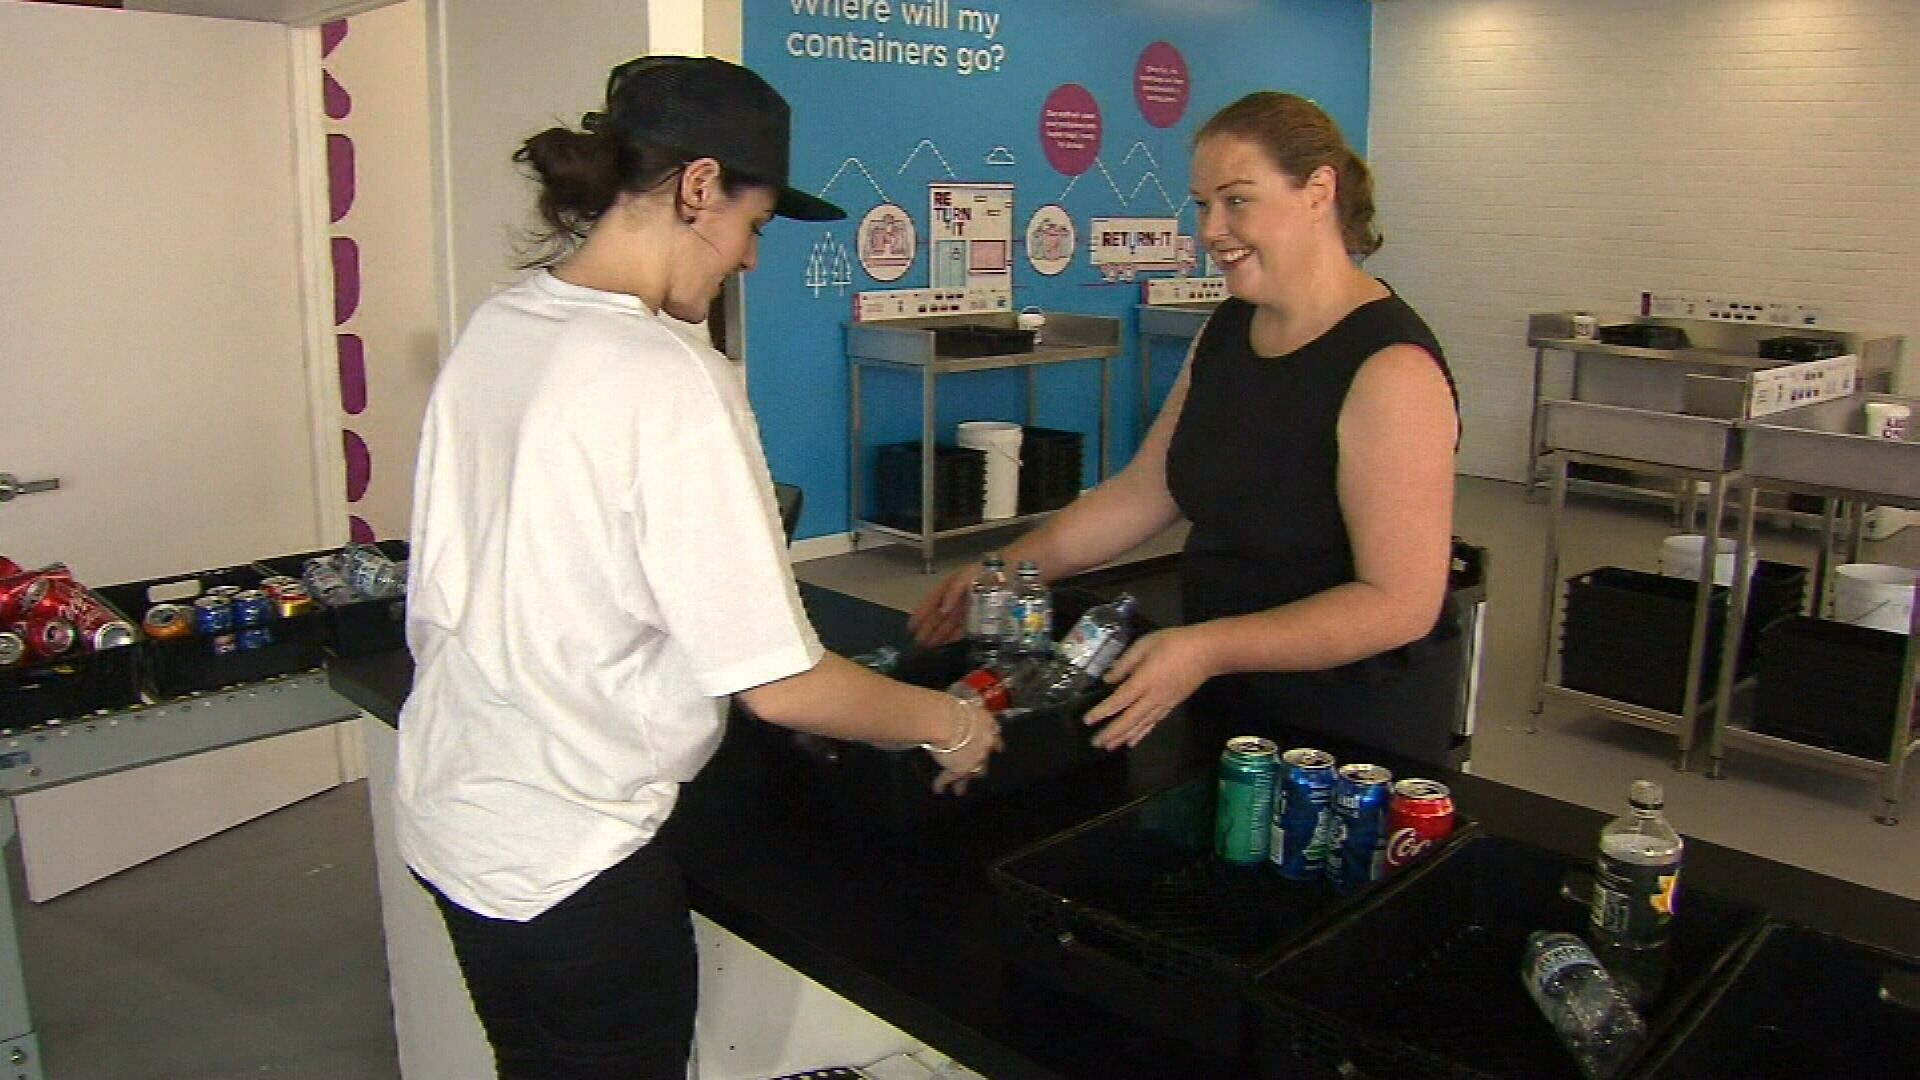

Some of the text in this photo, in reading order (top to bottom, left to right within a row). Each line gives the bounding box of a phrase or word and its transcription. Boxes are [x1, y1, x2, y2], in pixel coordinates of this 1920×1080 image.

[902, 0, 948, 28] will
[957, 8, 1000, 39] my
[786, 31, 1005, 75] containers go?
[934, 191, 952, 206] RE
[934, 207, 972, 225] TURN
